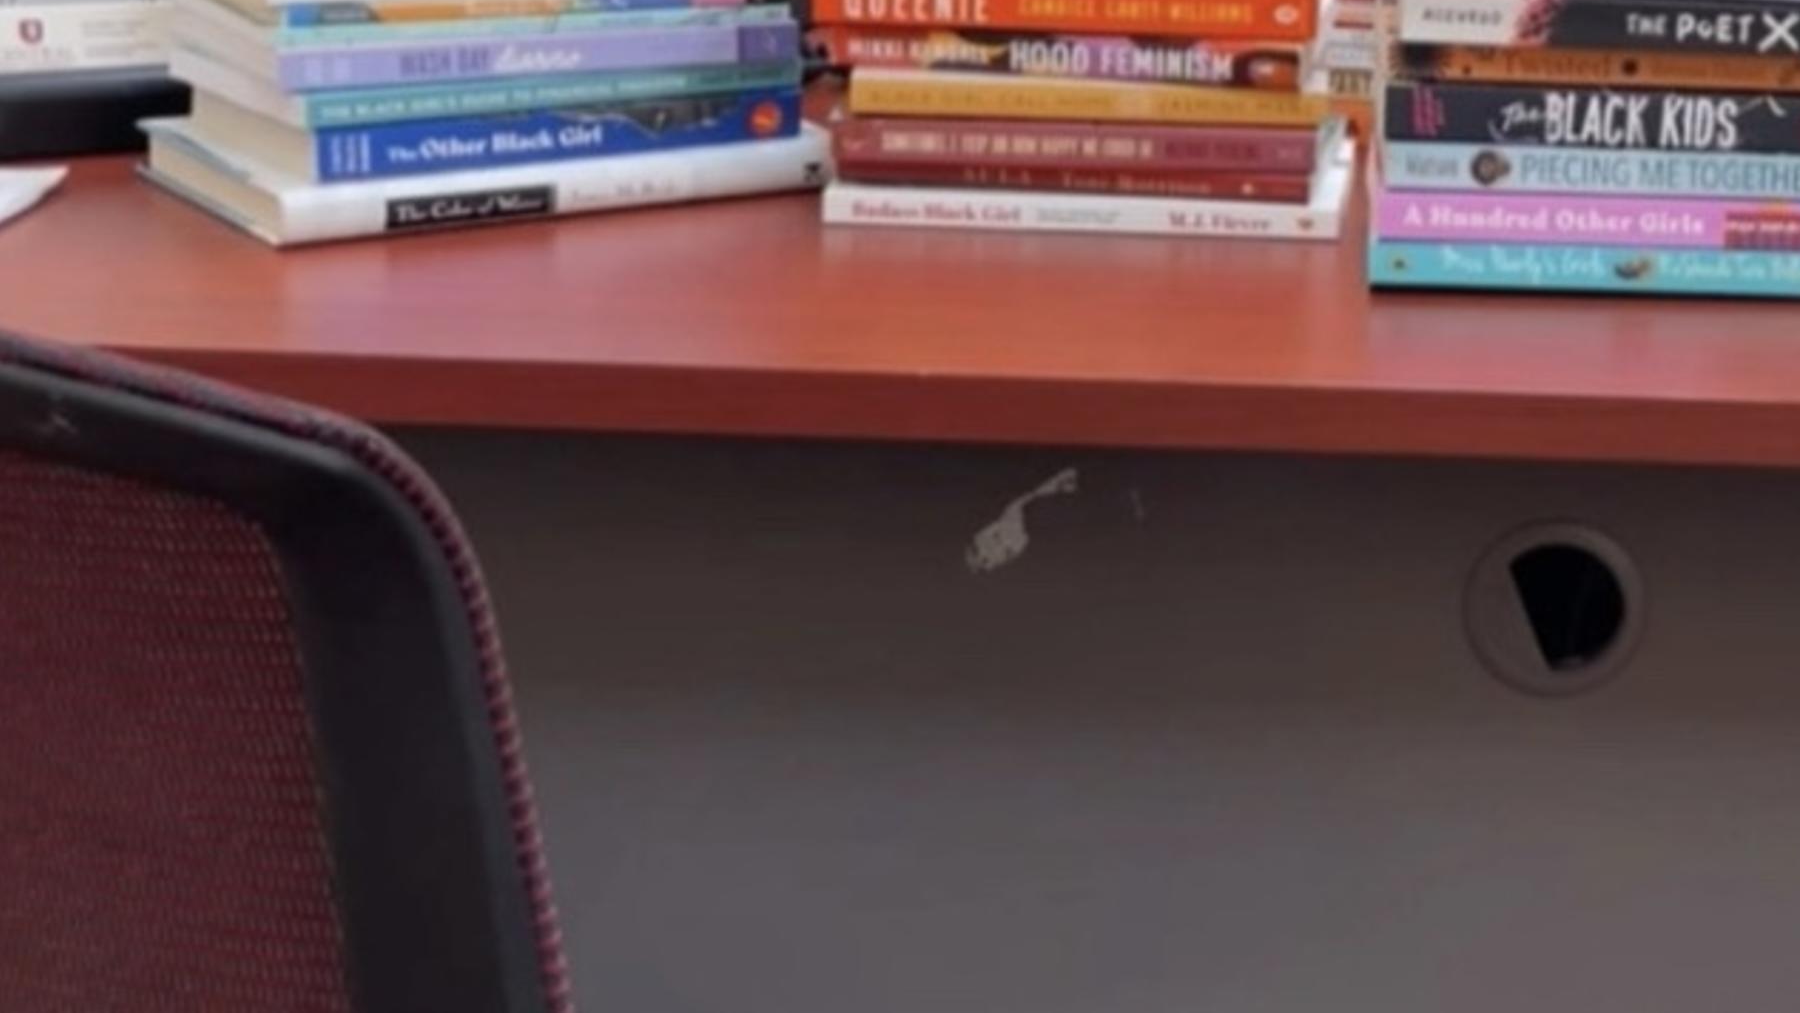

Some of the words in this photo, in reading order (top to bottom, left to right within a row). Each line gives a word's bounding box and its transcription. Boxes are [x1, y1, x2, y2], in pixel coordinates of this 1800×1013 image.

[1626, 12, 1669, 35] THE
[1758, 11, 1800, 53] X
[1009, 40, 1090, 75] HOOD
[1101, 44, 1234, 81] FEMINISM
[1544, 91, 1648, 147] BLACK
[1659, 93, 1740, 150] KIDS
[387, 146, 418, 163] The
[419, 136, 487, 161] Other
[491, 128, 553, 154] Black
[558, 123, 603, 148] Girl
[1520, 154, 1632, 188] PIECING
[1638, 157, 1682, 188] ME
[395, 204, 427, 223] The
[923, 201, 976, 221] Black
[982, 204, 1021, 222] Girl
[1404, 203, 1422, 227] A
[1429, 204, 1548, 231] Hundred
[1554, 208, 1633, 233] Other
[1638, 211, 1705, 236] Girls
